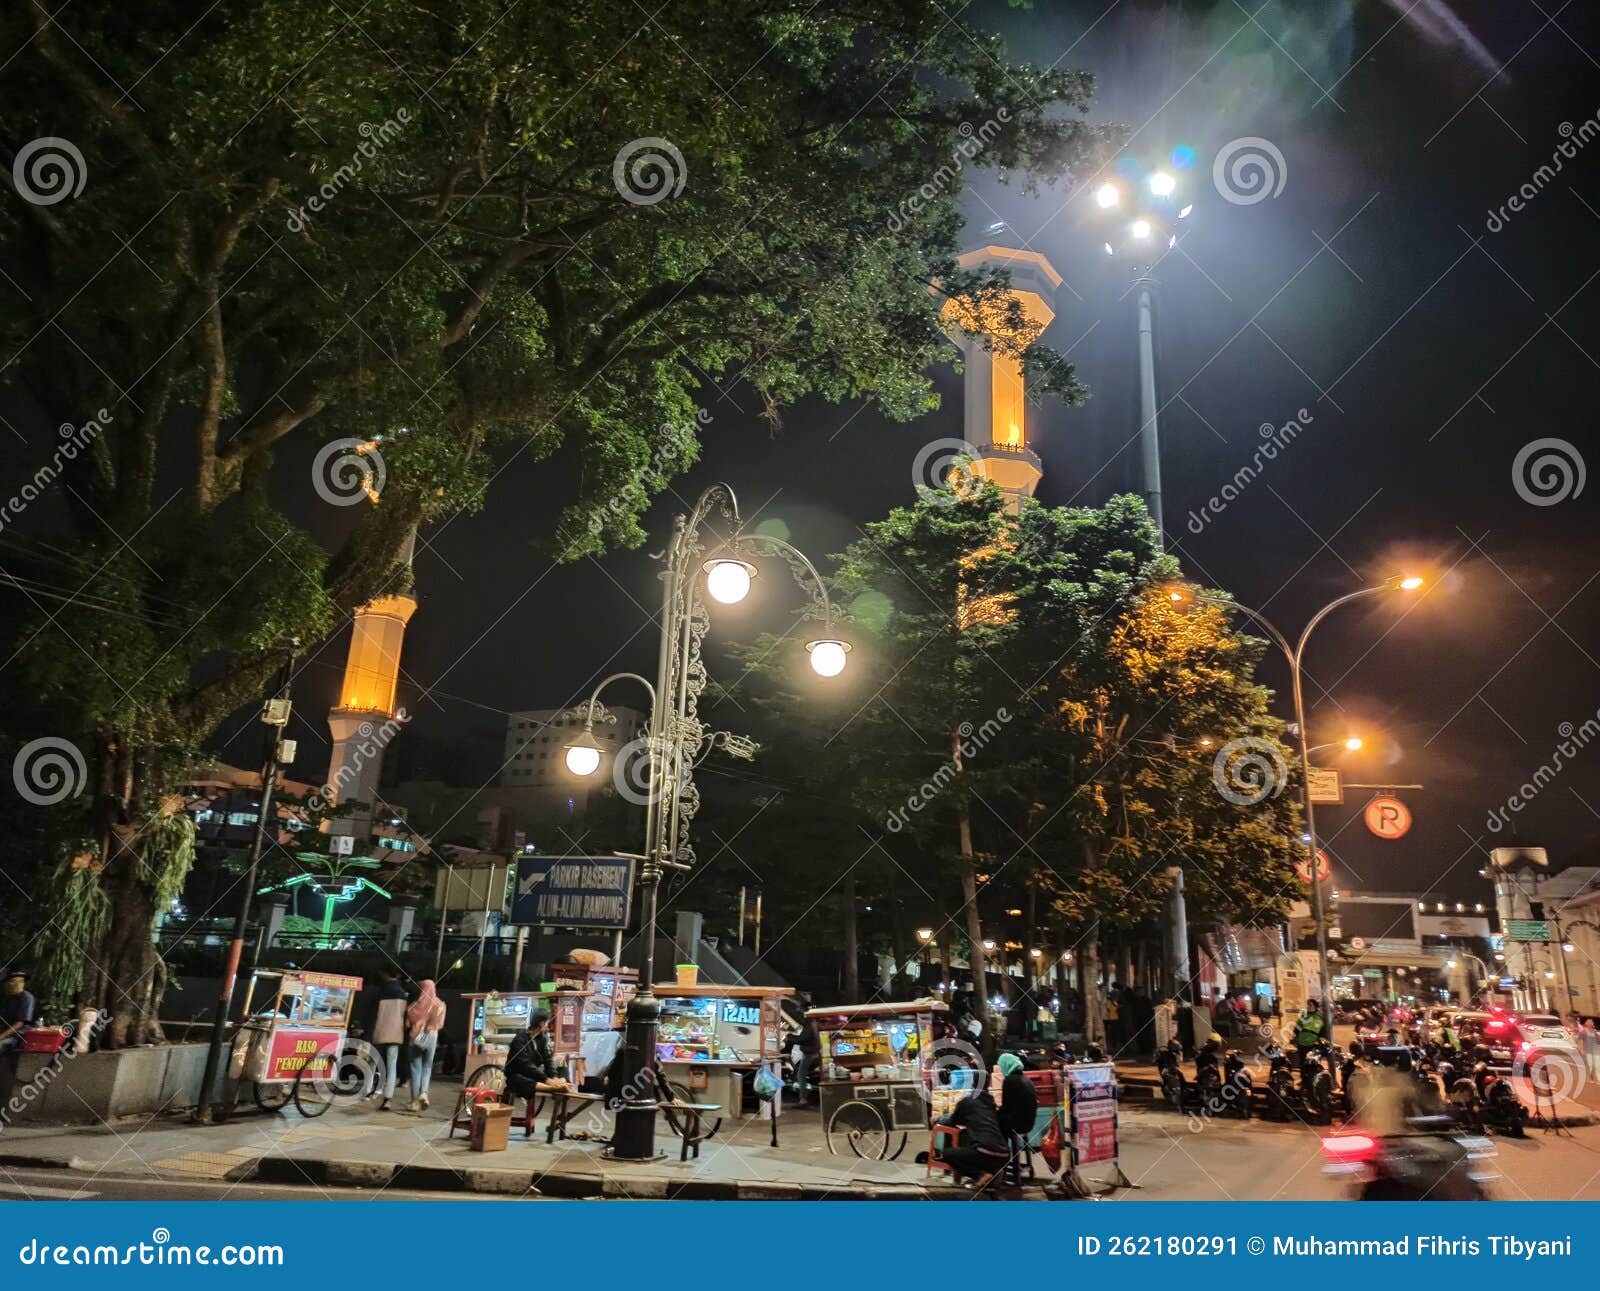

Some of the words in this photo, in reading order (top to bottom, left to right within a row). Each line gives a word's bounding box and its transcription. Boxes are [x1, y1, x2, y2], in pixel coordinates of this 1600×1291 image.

[1380, 806, 1398, 829] P
[549, 865, 580, 888] PARKIR
[580, 865, 627, 889] BASEMENT
[537, 894, 583, 917] ALUN-ALUN
[583, 895, 624, 919] BANDUNG
[295, 1039, 318, 1054] BASO
